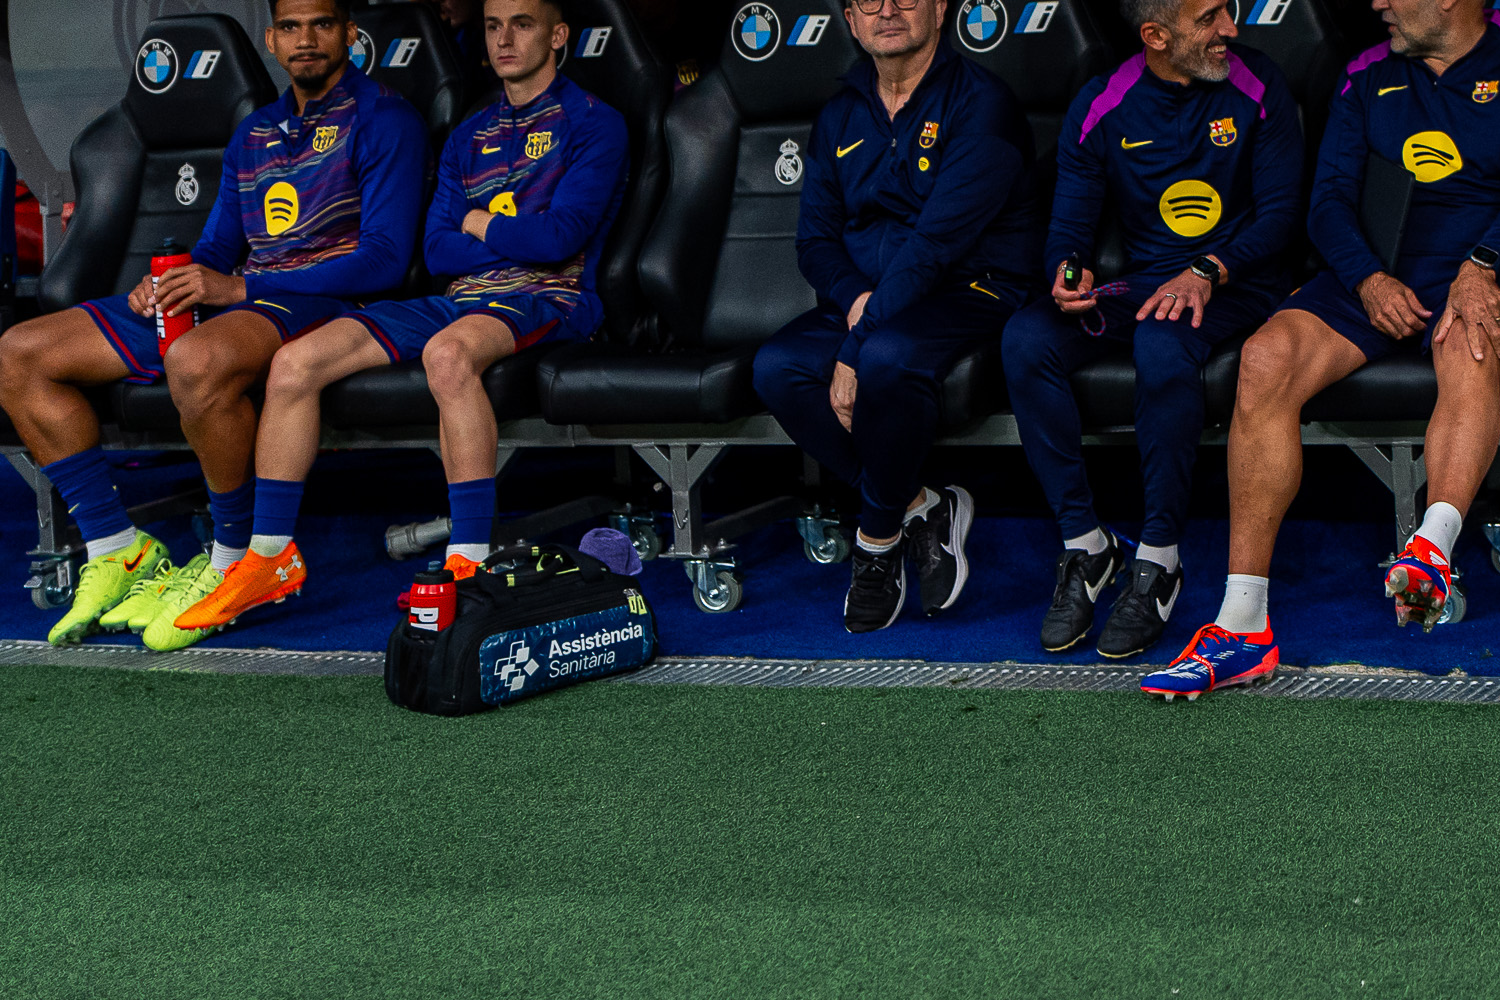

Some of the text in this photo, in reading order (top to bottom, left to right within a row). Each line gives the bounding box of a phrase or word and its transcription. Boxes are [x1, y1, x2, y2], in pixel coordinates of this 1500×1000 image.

[738, 6, 774, 23] BMW
[140, 43, 172, 58] BMW
[549, 621, 644, 659] Assistència
[549, 648, 616, 679] Sanitària
